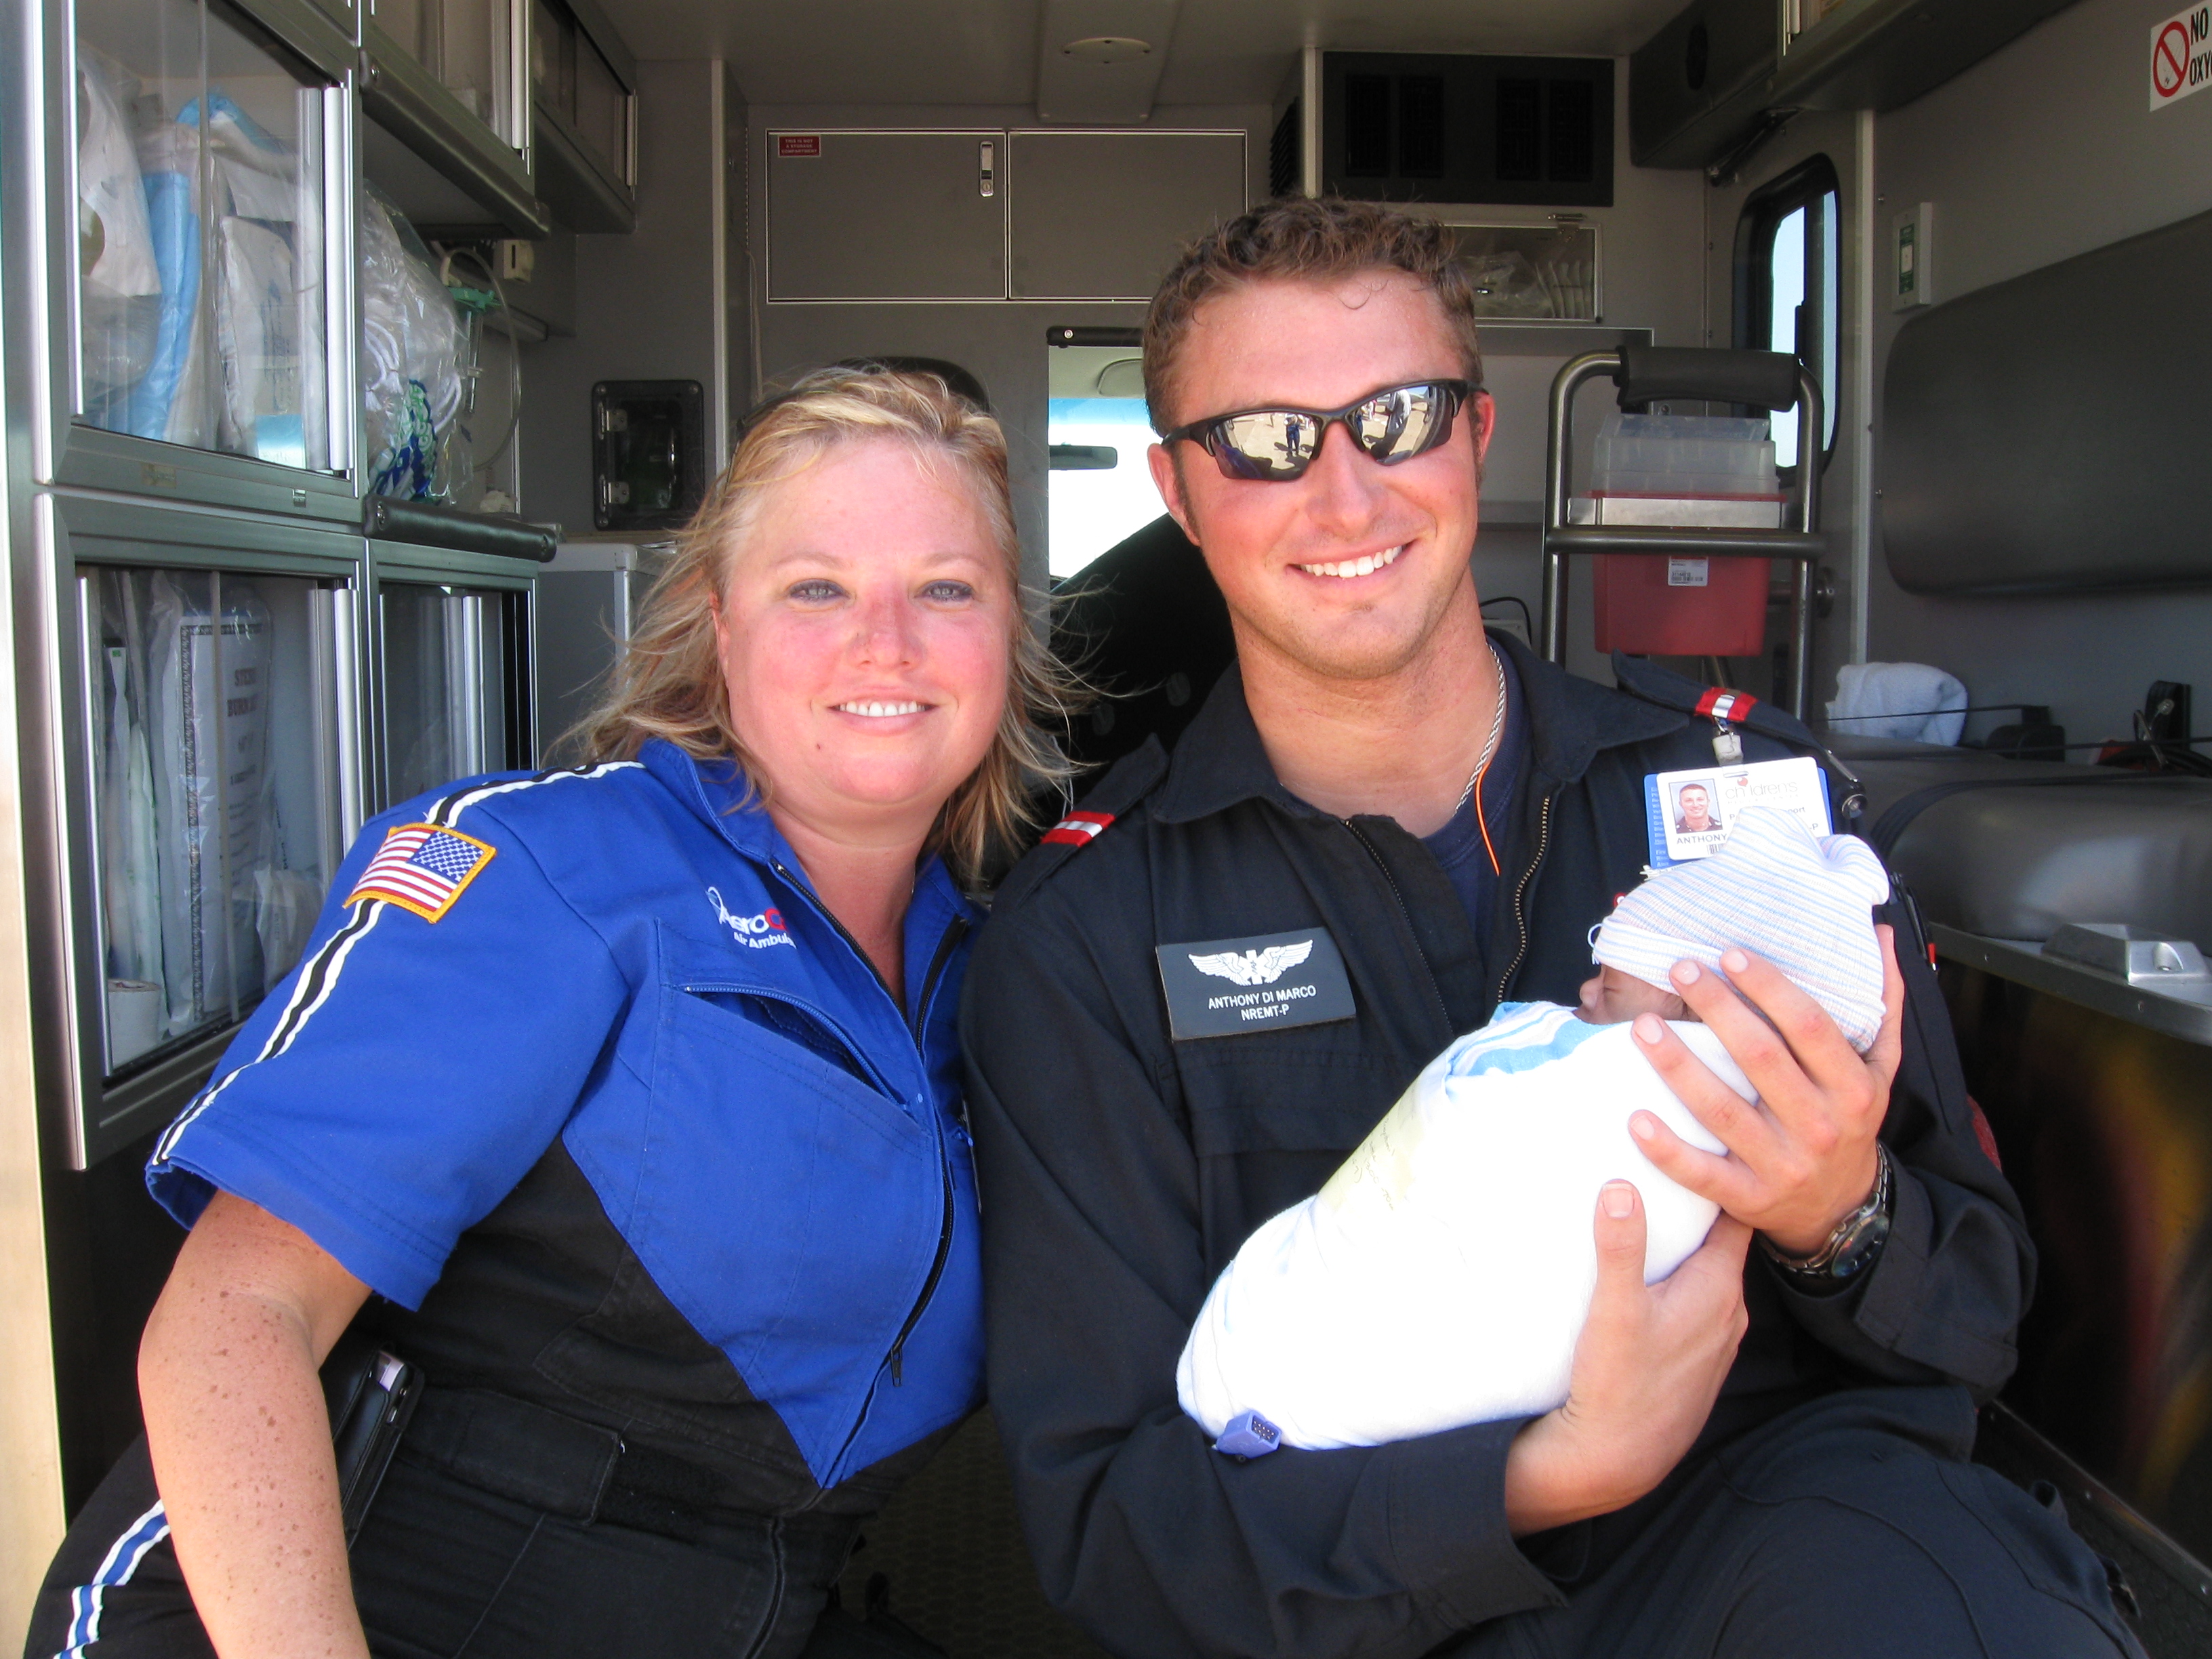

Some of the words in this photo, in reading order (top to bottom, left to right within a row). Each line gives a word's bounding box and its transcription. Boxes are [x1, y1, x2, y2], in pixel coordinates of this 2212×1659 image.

[2190, 7, 2209, 45] NO
[2189, 49, 2212, 87] OXY
[1677, 834, 1727, 845] ANTHONY
[734, 931, 748, 946] Air
[1208, 993, 1260, 1010] ANTHONY
[1262, 991, 1274, 1004] DI
[1276, 985, 1317, 1002] MARCO
[1240, 1003, 1290, 1021] NREMT-P
